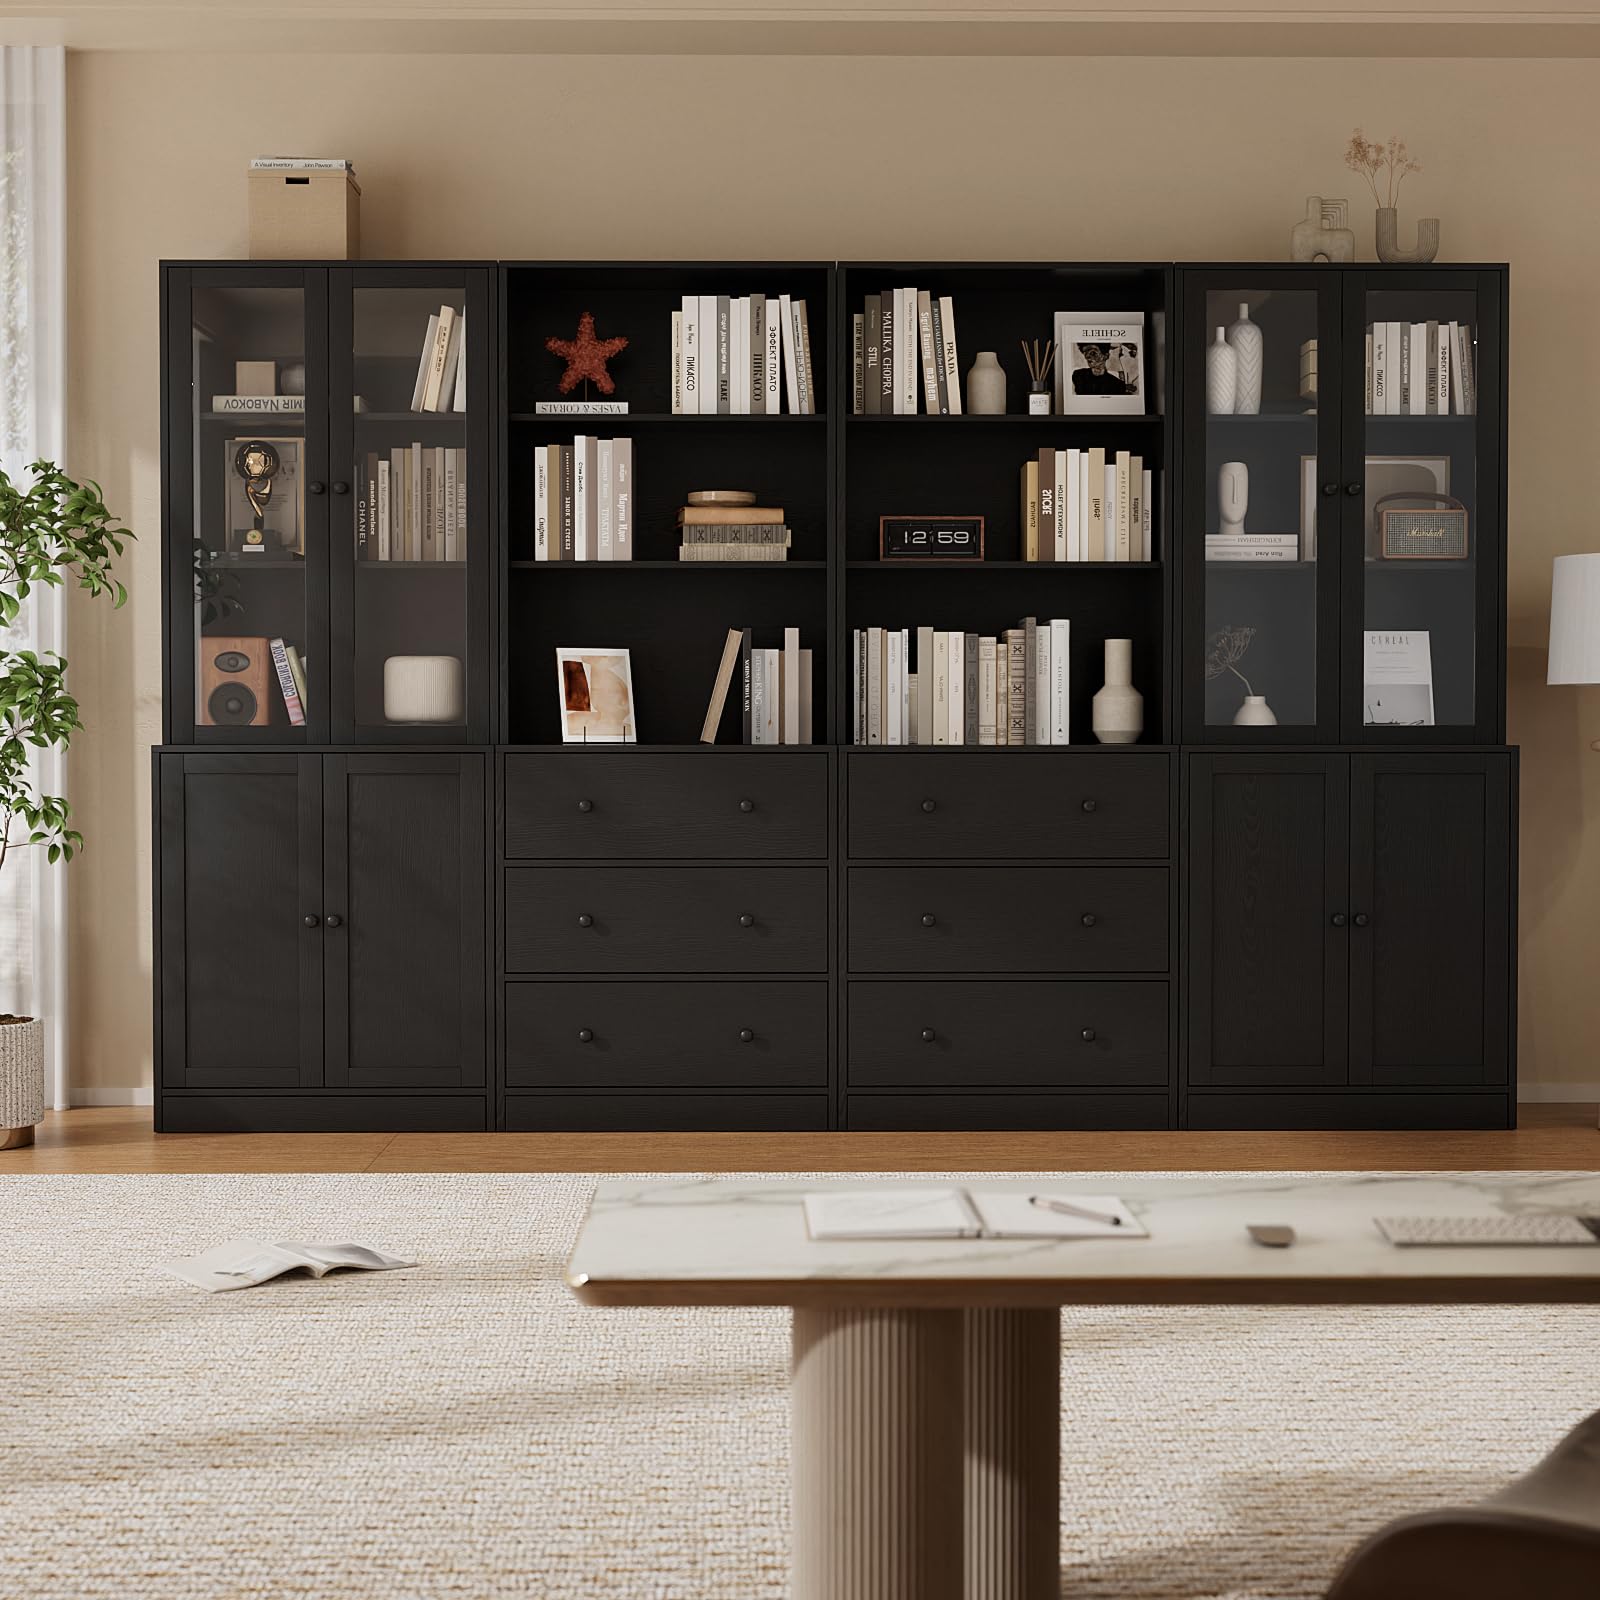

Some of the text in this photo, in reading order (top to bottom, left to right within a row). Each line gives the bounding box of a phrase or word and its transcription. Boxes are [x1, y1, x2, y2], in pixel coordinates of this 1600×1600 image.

[921, 312, 931, 332] Sigrid
[856, 351, 863, 359] ME
[868, 347, 878, 368] STILL
[883, 311, 892, 395] MALLIKA CHOPRA
[947, 342, 955, 376] PRADA
[686, 356, 695, 391] ПИКАССО
[753, 353, 762, 401] ПИКАССО
[925, 368, 937, 401] mayhem
[1376, 369, 1384, 397] ПИКАССО
[1428, 367, 1437, 405] ПИКАССО
[224, 399, 279, 411] NABOKOV
[541, 404, 621, 413] VASES & CORALS
[617, 493, 628, 521] Мартин
[617, 523, 628, 542] Иден
[904, 531, 969, 544] 12 59
[1371, 635, 1409, 645] CEREAL
[754, 682, 763, 705] KING
